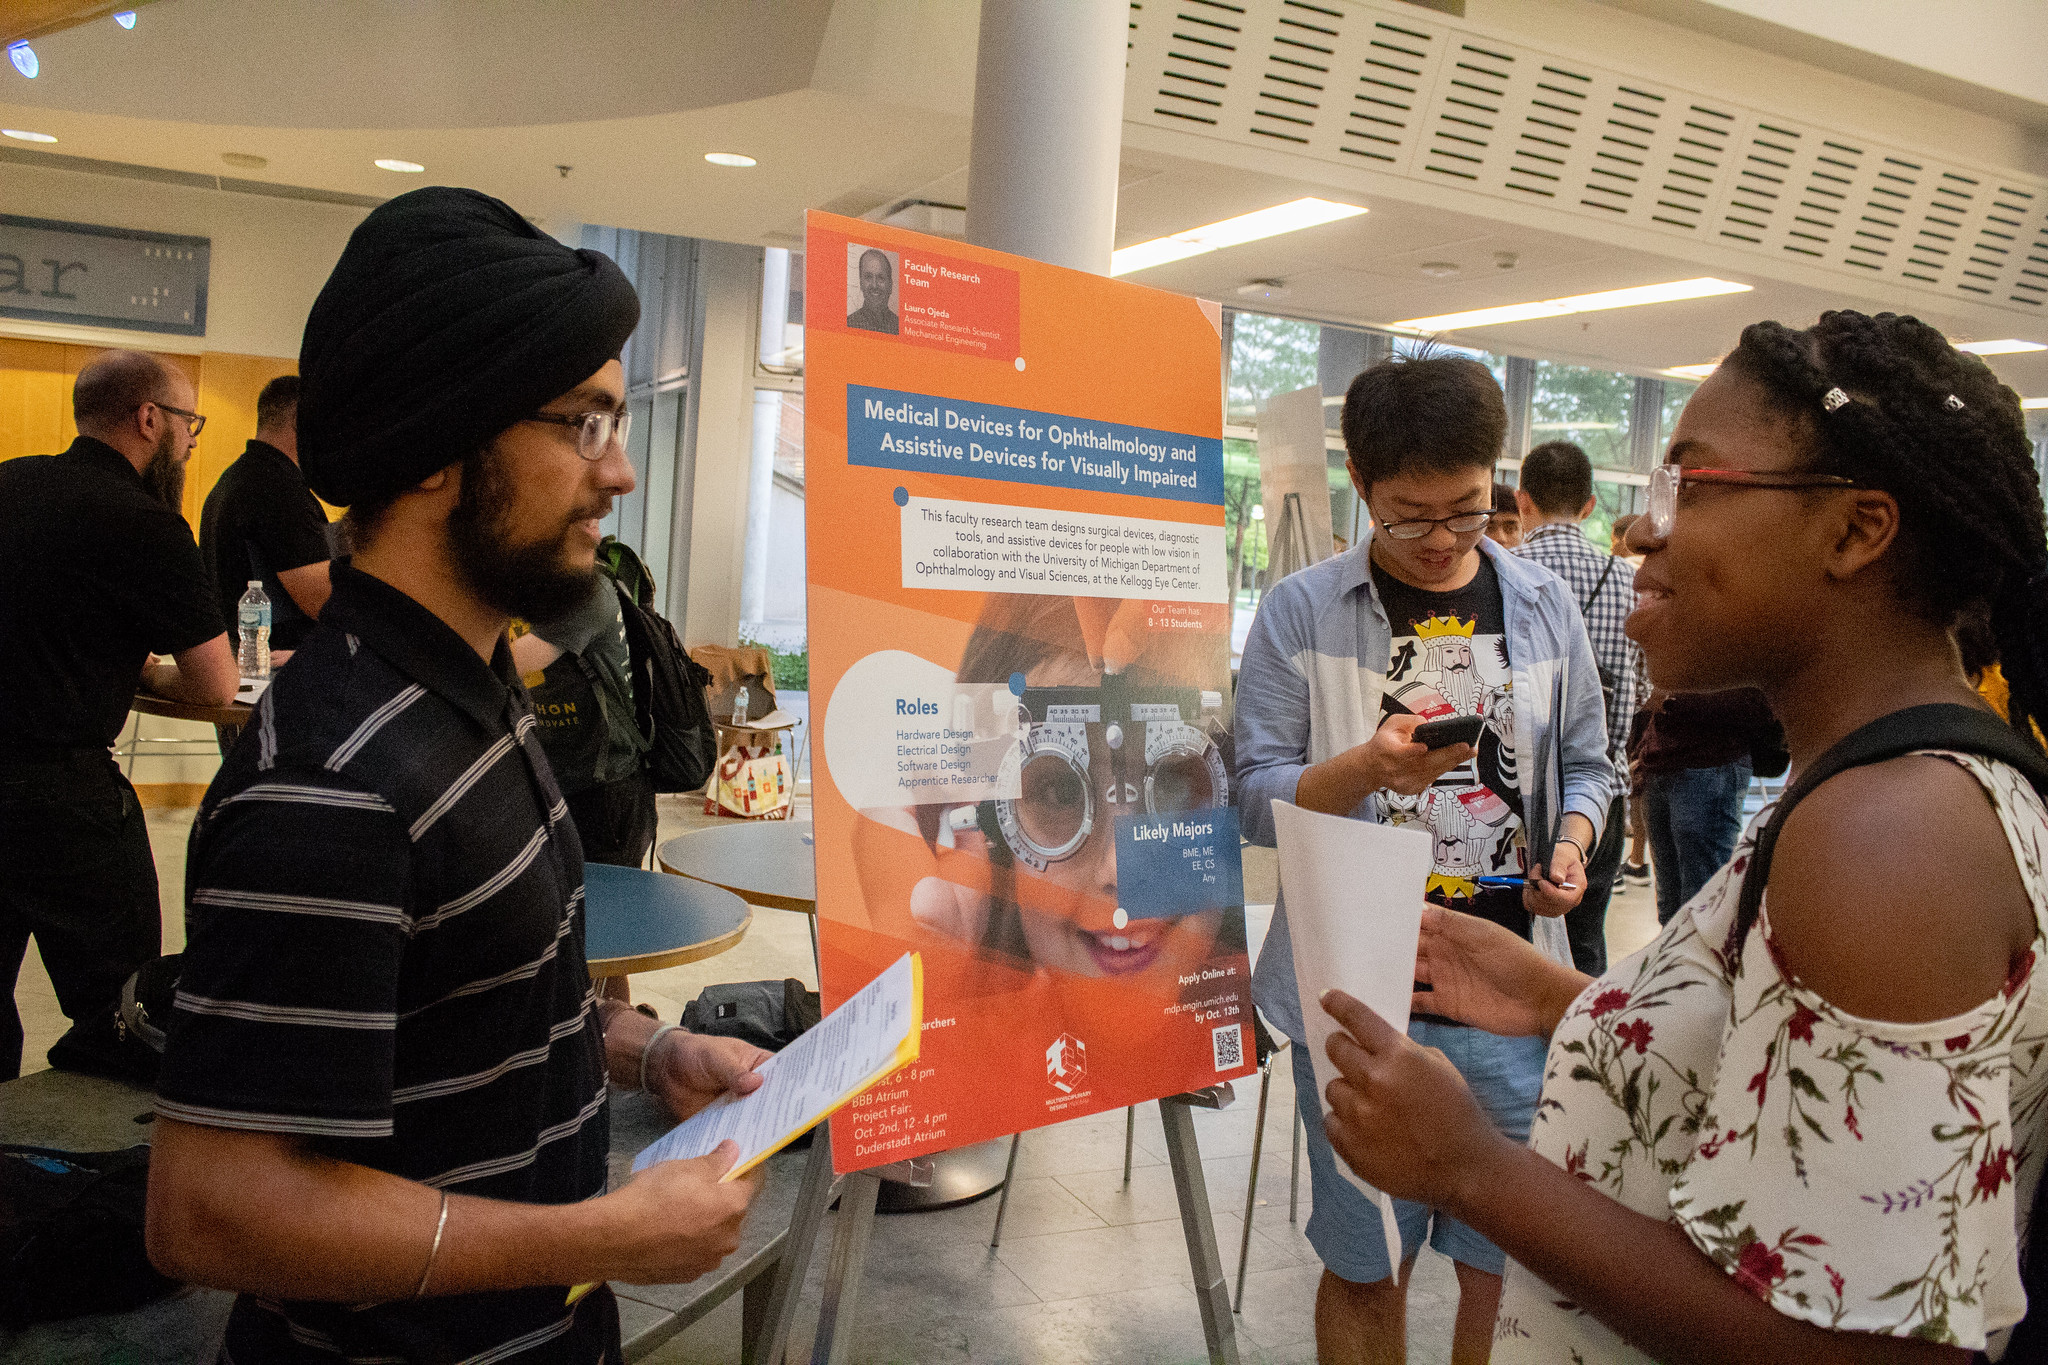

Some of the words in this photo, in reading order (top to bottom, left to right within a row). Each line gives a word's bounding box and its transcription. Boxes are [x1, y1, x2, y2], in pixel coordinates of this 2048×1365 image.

[904, 260, 938, 278] Faculty
[940, 267, 980, 284] Research
[904, 274, 930, 288] Team
[904, 303, 926, 314] Lauro
[927, 307, 950, 318] Ojeda
[904, 315, 938, 329] Associate
[940, 322, 971, 335] Research
[972, 327, 1002, 341] Scientist,
[904, 327, 944, 341] Mechanical
[946, 334, 987, 350] Engineering
[864, 398, 939, 427] Medical
[945, 410, 1014, 437] Devices
[1018, 419, 1043, 440] for
[1048, 425, 1167, 463] Ophthalmology
[1171, 445, 1196, 462] and
[880, 432, 963, 460] Assistive
[970, 443, 1037, 469] Devices
[1041, 451, 1066, 472] for
[1070, 456, 1130, 485] Visually
[1134, 464, 1197, 489] Impaired
[921, 509, 942, 522] This
[945, 511, 978, 528] faculty
[981, 517, 1022, 529] research
[1025, 520, 1049, 531] team
[1051, 521, 1086, 536] designs
[1088, 526, 1121, 539] surgical
[1123, 528, 1157, 542] devices,
[1159, 531, 1200, 545] diagnostic
[956, 531, 983, 544] tools,
[987, 533, 1005, 544] and
[1007, 535, 1046, 547] assistive
[1049, 537, 1082, 550] devices
[1085, 540, 1097, 551] for
[1100, 542, 1130, 556] people
[1132, 544, 1150, 555] with
[1152, 546, 1166, 557] low
[1168, 548, 1191, 559] vision
[1193, 549, 1200, 559] in
[933, 546, 999, 561] collaboration
[1002, 551, 1022, 563] with
[1025, 552, 1040, 564] the
[1043, 553, 1087, 570] University
[1090, 556, 1098, 567] of
[1101, 558, 1140, 573] Michigan
[1142, 560, 1190, 574] Department
[1192, 564, 1200, 574] of
[916, 562, 996, 581] Ophthalmology
[999, 568, 1016, 579] and
[1018, 568, 1046, 581] Visual
[1050, 570, 1090, 585] Sciences,
[1093, 575, 1101, 584] at
[1104, 574, 1118, 585] the
[1120, 575, 1153, 590] Kellogg
[1155, 577, 1169, 590] Eye
[1172, 578, 1201, 590] Center.
[1152, 604, 1166, 614] Our
[1168, 605, 1187, 615] Team
[1188, 606, 1202, 616] has:
[1149, 618, 1153, 626] 8
[1160, 618, 1169, 627] 13
[1171, 619, 1202, 629] Students
[896, 698, 939, 715] Roles
[897, 729, 940, 740] Hardware
[944, 729, 974, 741] Design
[898, 745, 938, 756] Electrical
[941, 744, 971, 756] Design
[898, 760, 938, 772] Software
[940, 759, 971, 772] Design
[898, 776, 948, 789] Apprentice
[951, 773, 999, 784] Researcher
[1134, 824, 1169, 843] Likely
[1173, 821, 1213, 840] Majors
[1182, 848, 1201, 858] BME,
[1203, 846, 1214, 856] ME
[1192, 861, 1204, 871] EE,
[1205, 859, 1215, 869] CS
[1203, 874, 1216, 884] Any
[1178, 972, 1200, 986] Apply
[1202, 969, 1225, 980] Online
[1164, 992, 1239, 1015] mdp.engin.umich.edu
[1195, 1013, 1204, 1024] by
[1206, 1010, 1221, 1020] Oct.
[1224, 1005, 1240, 1017] 13th
[921, 1018, 956, 1031] archers
[877, 1075, 892, 1087] st,
[896, 1073, 902, 1083] 6
[911, 1070, 917, 1080] 8
[920, 1068, 935, 1082] pm
[852, 1094, 873, 1108] BBB
[876, 1089, 909, 1103] Atrium
[853, 1109, 888, 1124] Project
[891, 1104, 912, 1116] Fair:
[855, 1128, 875, 1141] Oct.
[879, 1122, 900, 1135] 2nd,
[904, 1118, 915, 1130] 12
[924, 1114, 930, 1124] 4
[932, 1113, 948, 1127] pm
[855, 1135, 911, 1157] Duderstadt
[914, 1129, 946, 1143] Atrium
